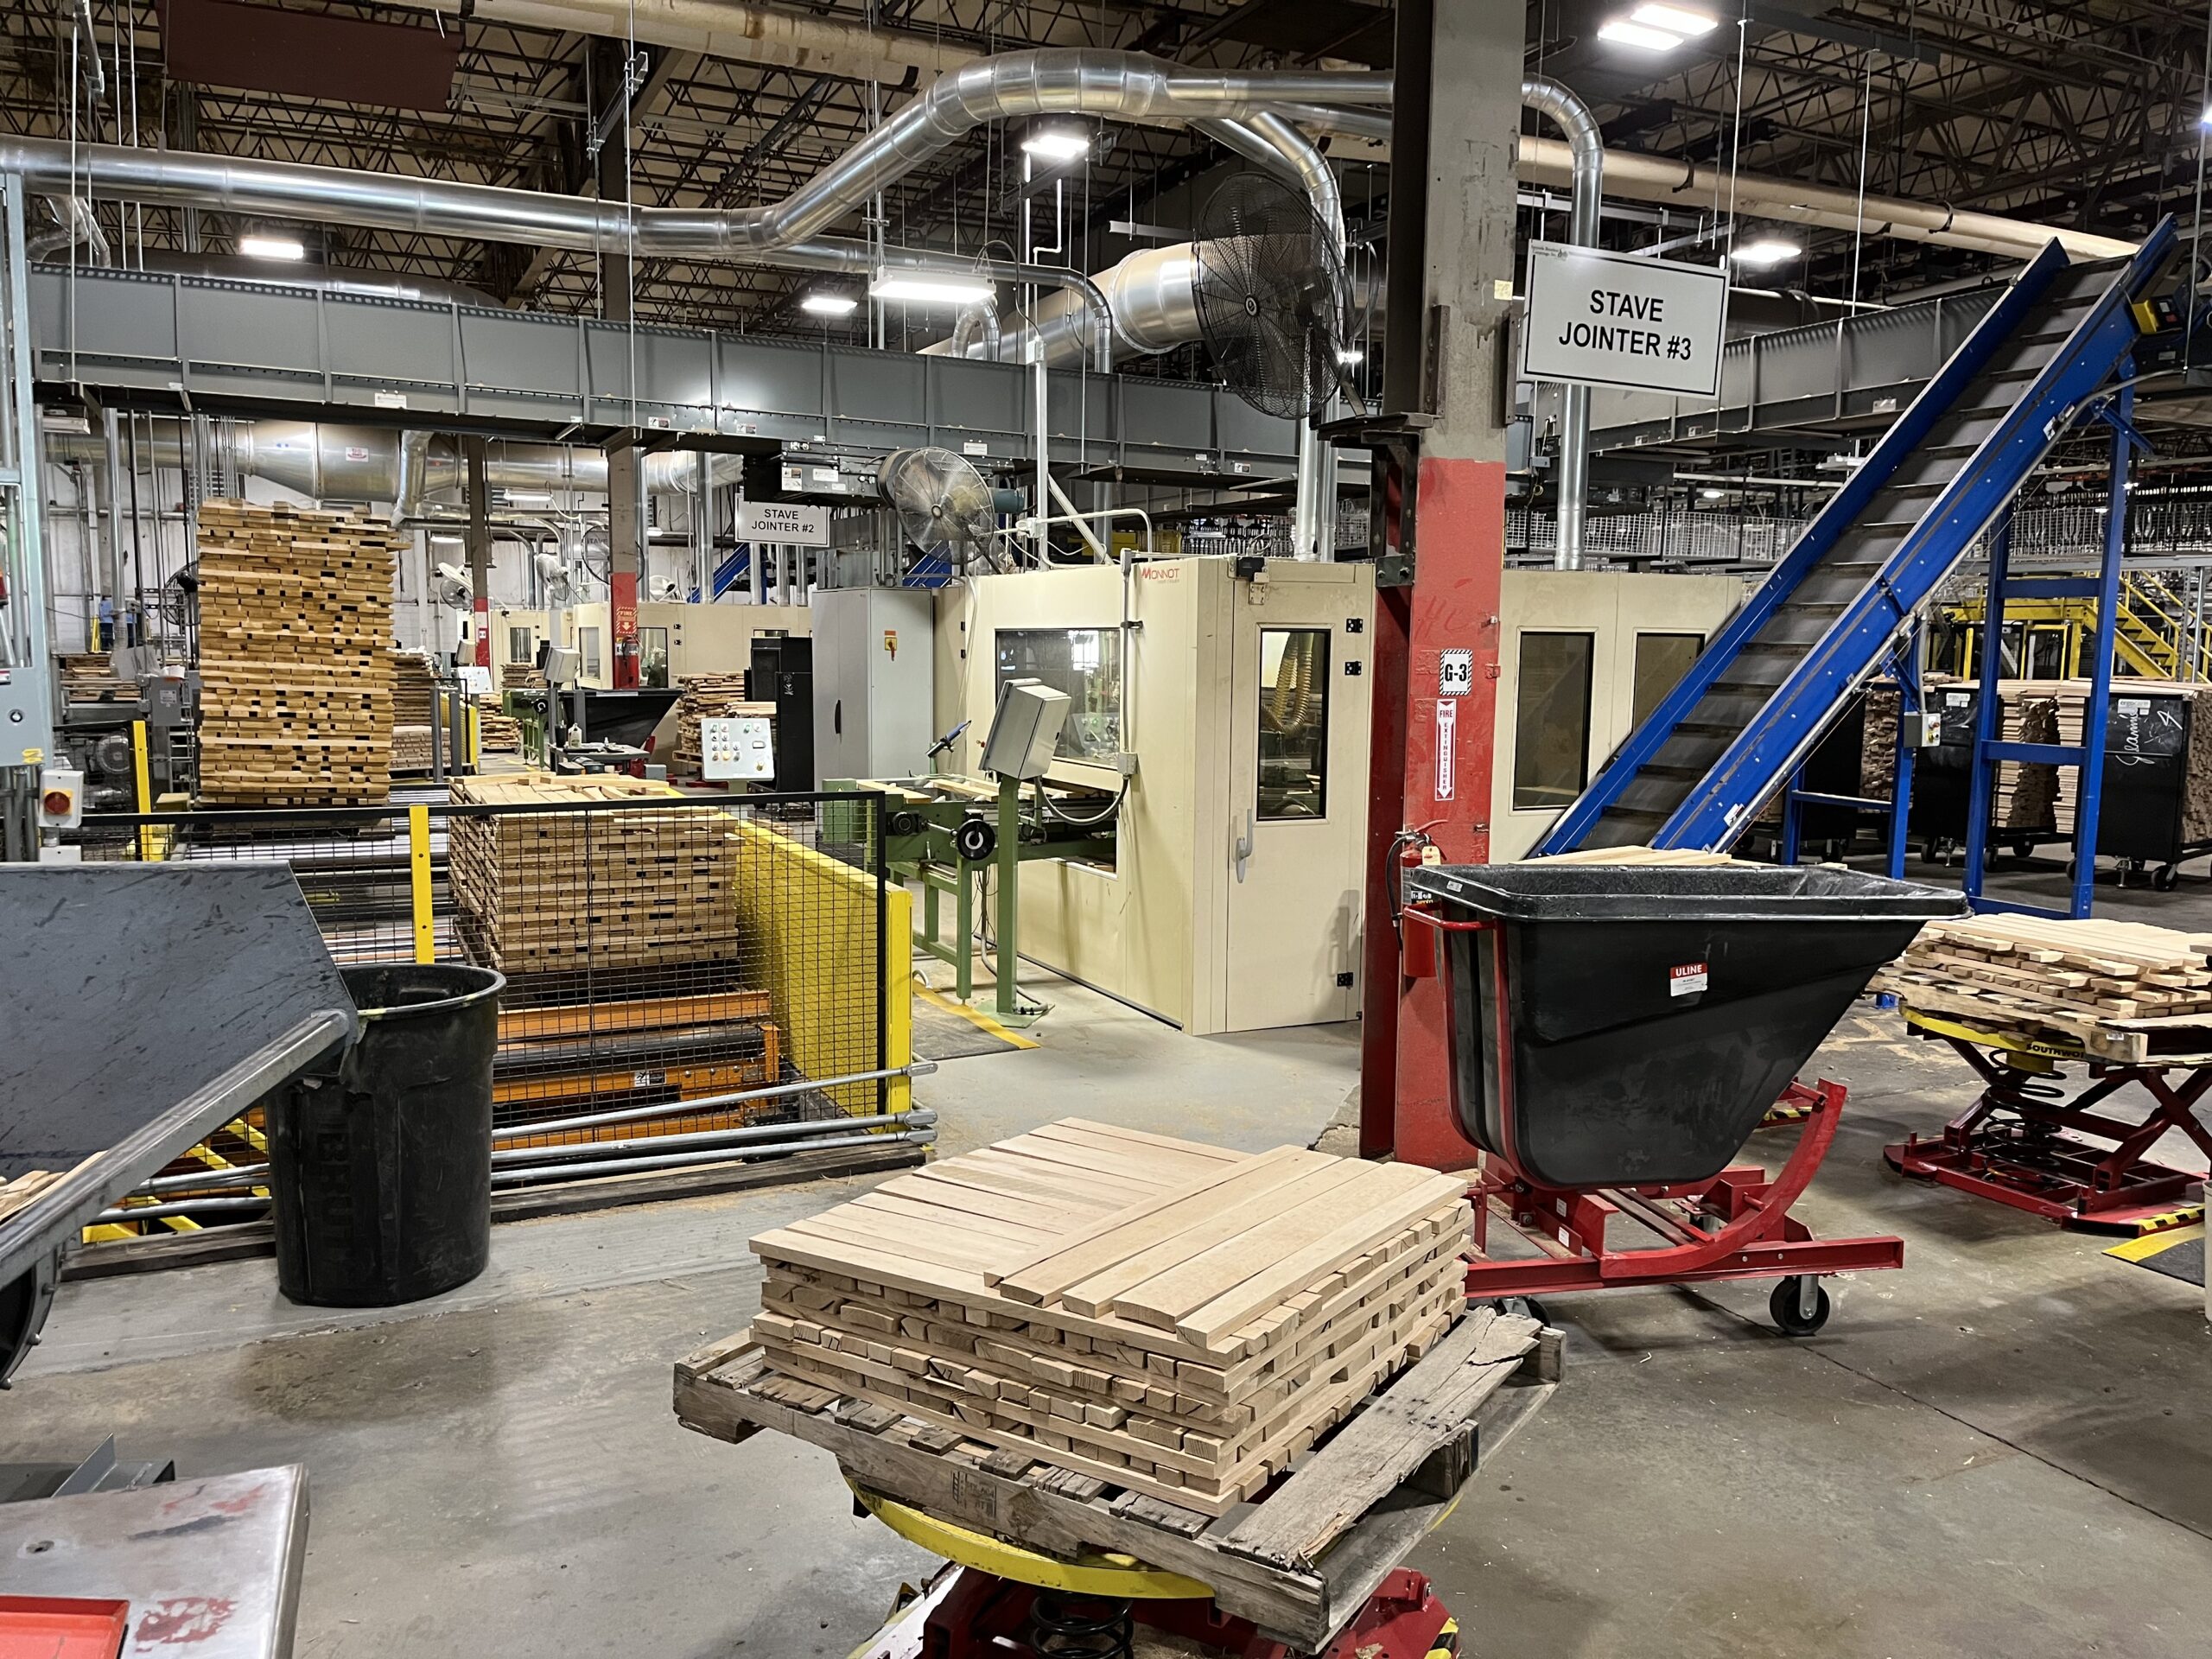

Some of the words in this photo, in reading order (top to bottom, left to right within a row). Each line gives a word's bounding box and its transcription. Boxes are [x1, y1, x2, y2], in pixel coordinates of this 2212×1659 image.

[1590, 289, 1663, 322] STAVE
[1559, 321, 1661, 357] JOINTER
[1667, 335, 1692, 360] #3
[765, 509, 798, 520] STAVE
[752, 521, 799, 531] JOINTER
[802, 524, 814, 533] #2
[1141, 568, 1180, 580] MONNOT
[1445, 664, 1467, 682] G-3
[1676, 964, 1702, 976] ULINE
